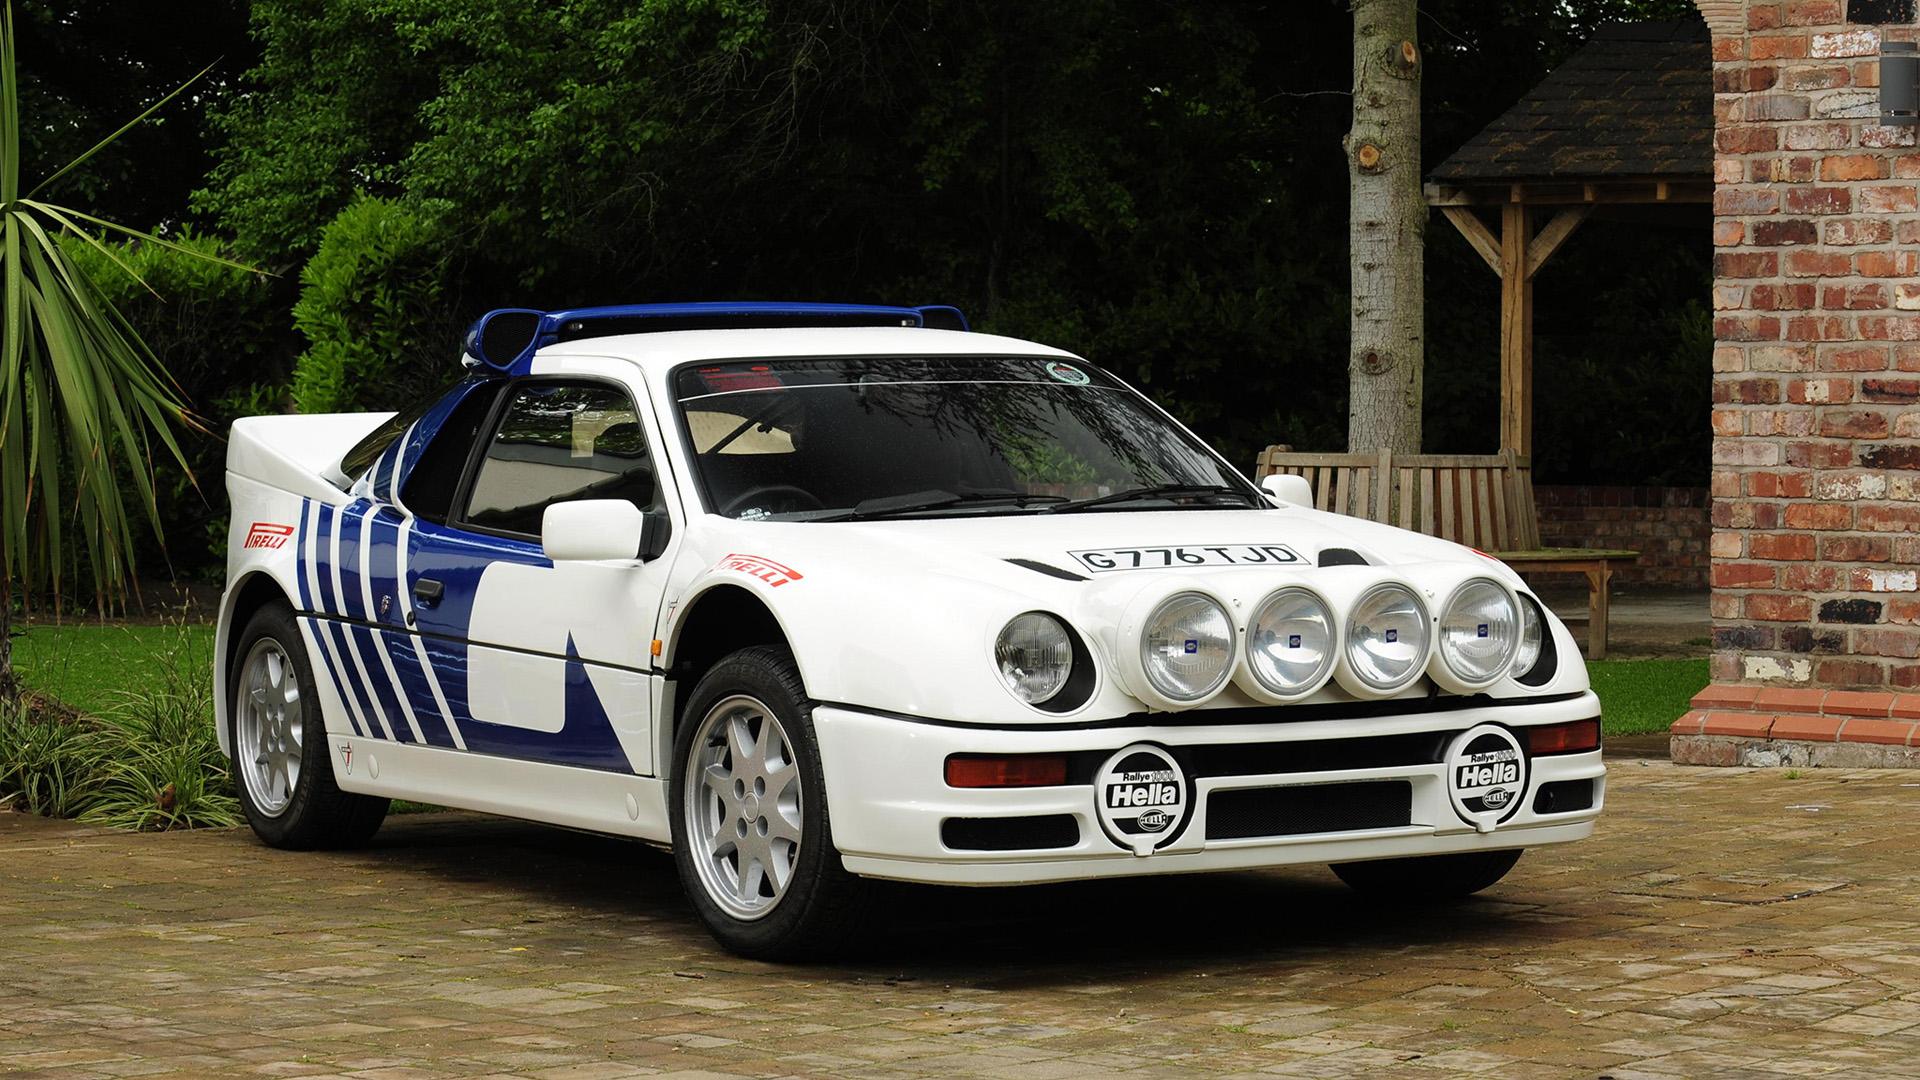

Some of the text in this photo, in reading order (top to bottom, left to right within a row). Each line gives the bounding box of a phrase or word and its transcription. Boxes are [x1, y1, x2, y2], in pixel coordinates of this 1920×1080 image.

[244, 522, 294, 549] PIRELLI
[1471, 752, 1495, 764] Rallye
[1123, 771, 1151, 783] Rallye
[1460, 762, 1517, 788] Hella
[1111, 783, 1176, 807] Hella
